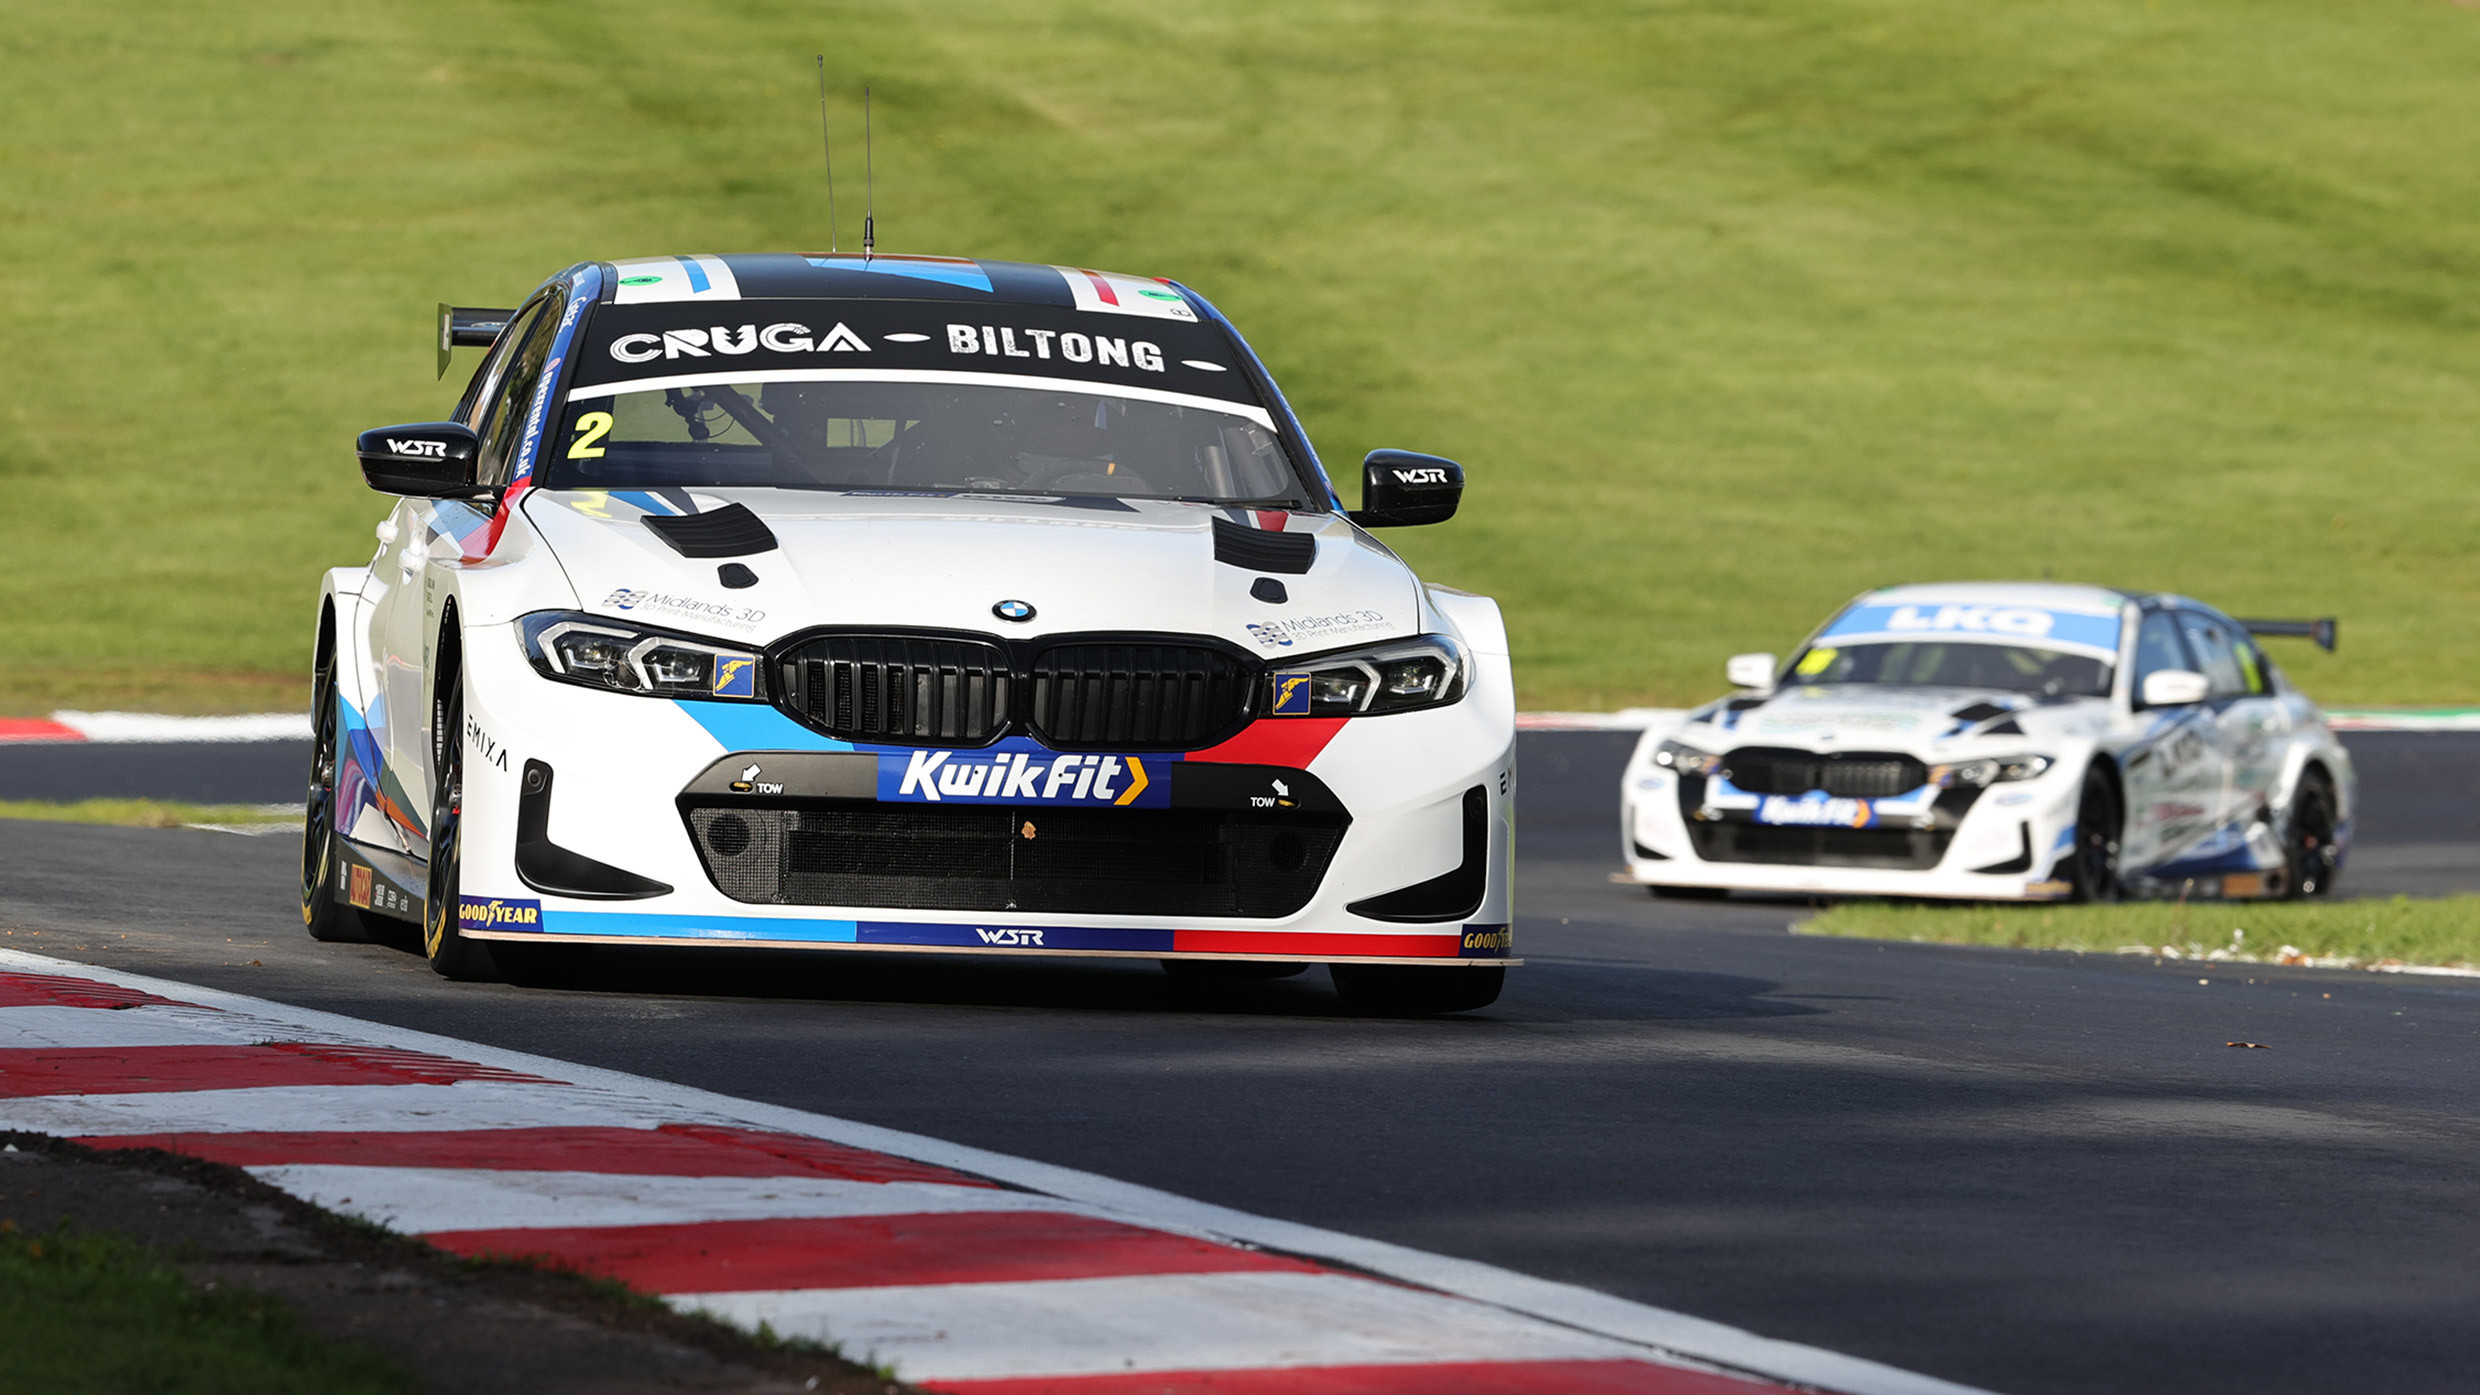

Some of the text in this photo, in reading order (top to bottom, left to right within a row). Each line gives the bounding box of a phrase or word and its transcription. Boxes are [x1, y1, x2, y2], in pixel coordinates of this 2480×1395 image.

[610, 321, 1165, 373] CRUGA BILTONG
[516, 371, 553, 479] apexrental.co.uk
[567, 411, 614, 459] 2
[386, 438, 447, 457] WSR
[1392, 468, 1448, 484] WSR
[646, 593, 767, 623] Midlands 3D
[1281, 610, 1384, 632] Midlands 3D
[1886, 606, 2055, 637] LKQ
[757, 782, 784, 794] TOW
[1250, 796, 1275, 808] TOW
[459, 902, 538, 924] GOODYEAR
[975, 928, 1045, 946] WSR
